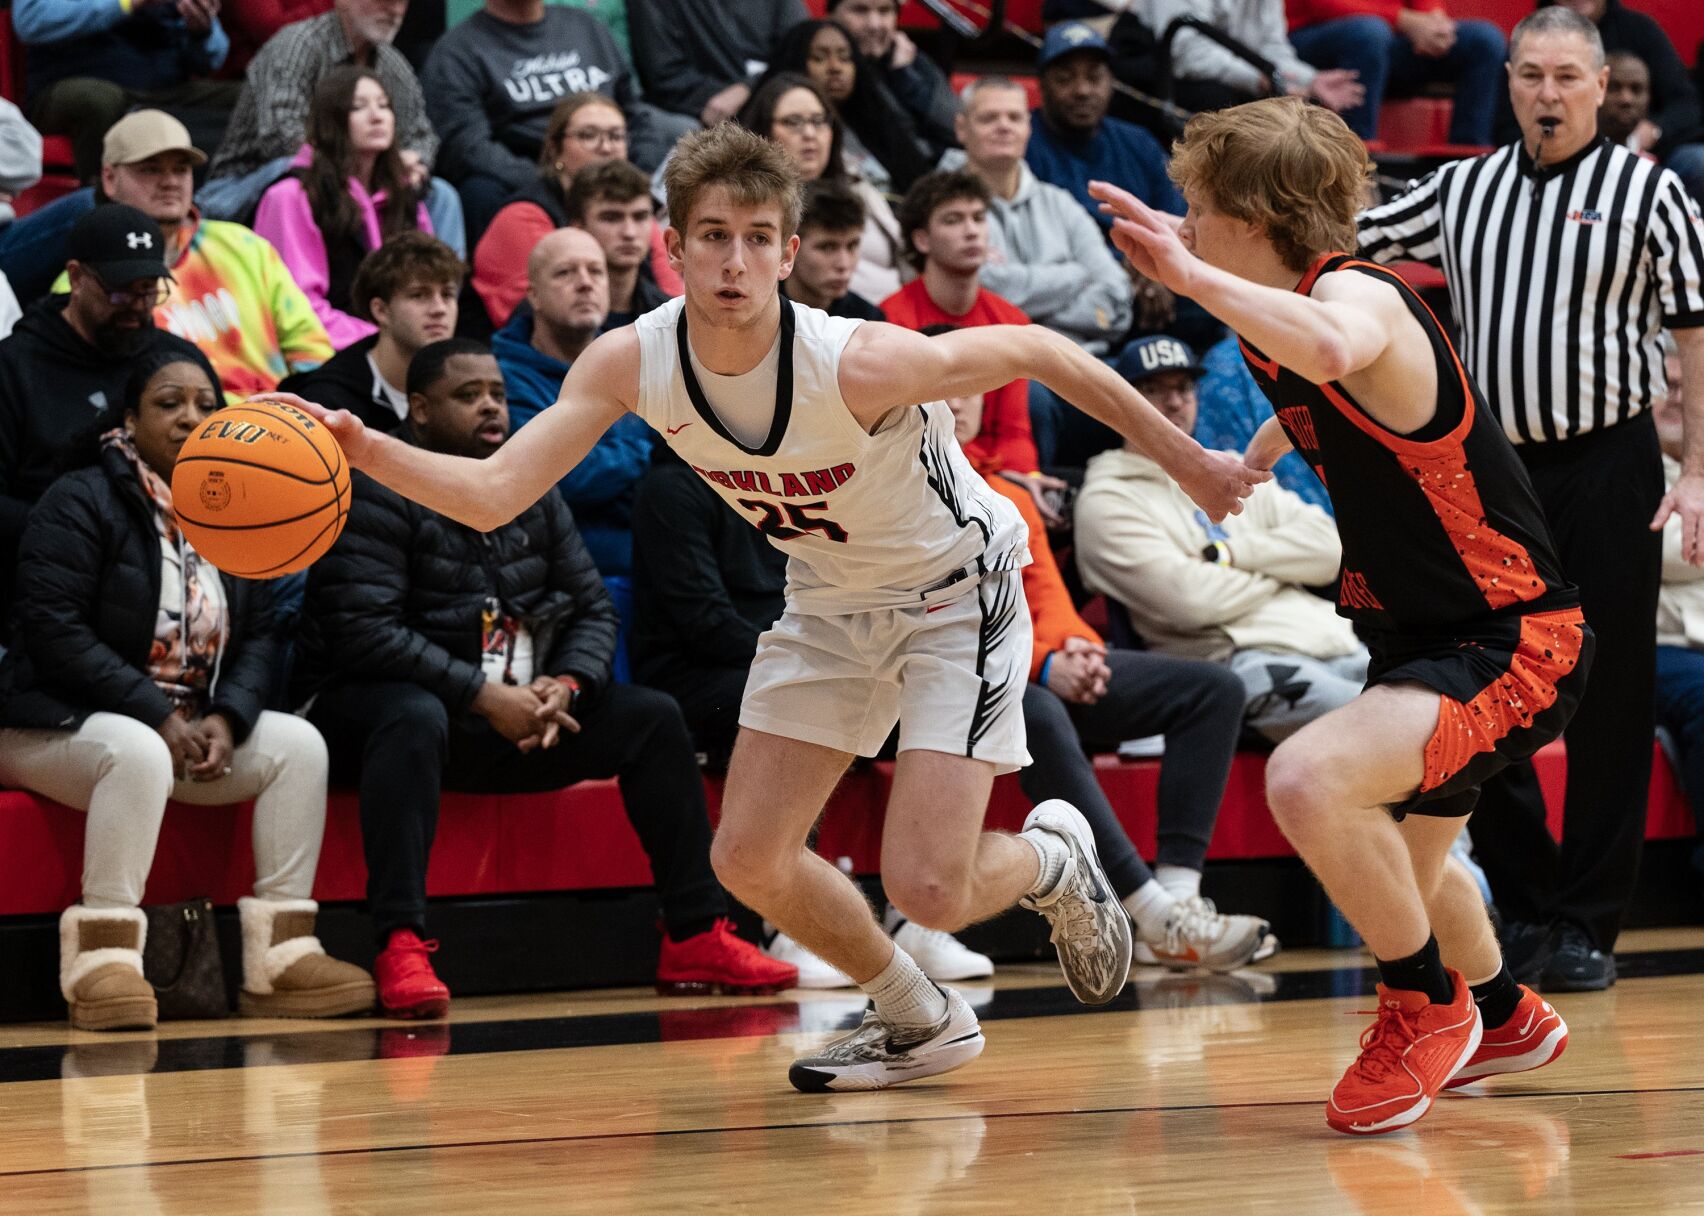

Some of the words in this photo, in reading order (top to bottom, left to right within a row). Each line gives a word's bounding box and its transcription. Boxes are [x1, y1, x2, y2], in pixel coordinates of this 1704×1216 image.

[503, 66, 612, 102] ULTRA
[1138, 339, 1190, 370] USA
[199, 420, 268, 444] EVO
[736, 498, 849, 543] 25
